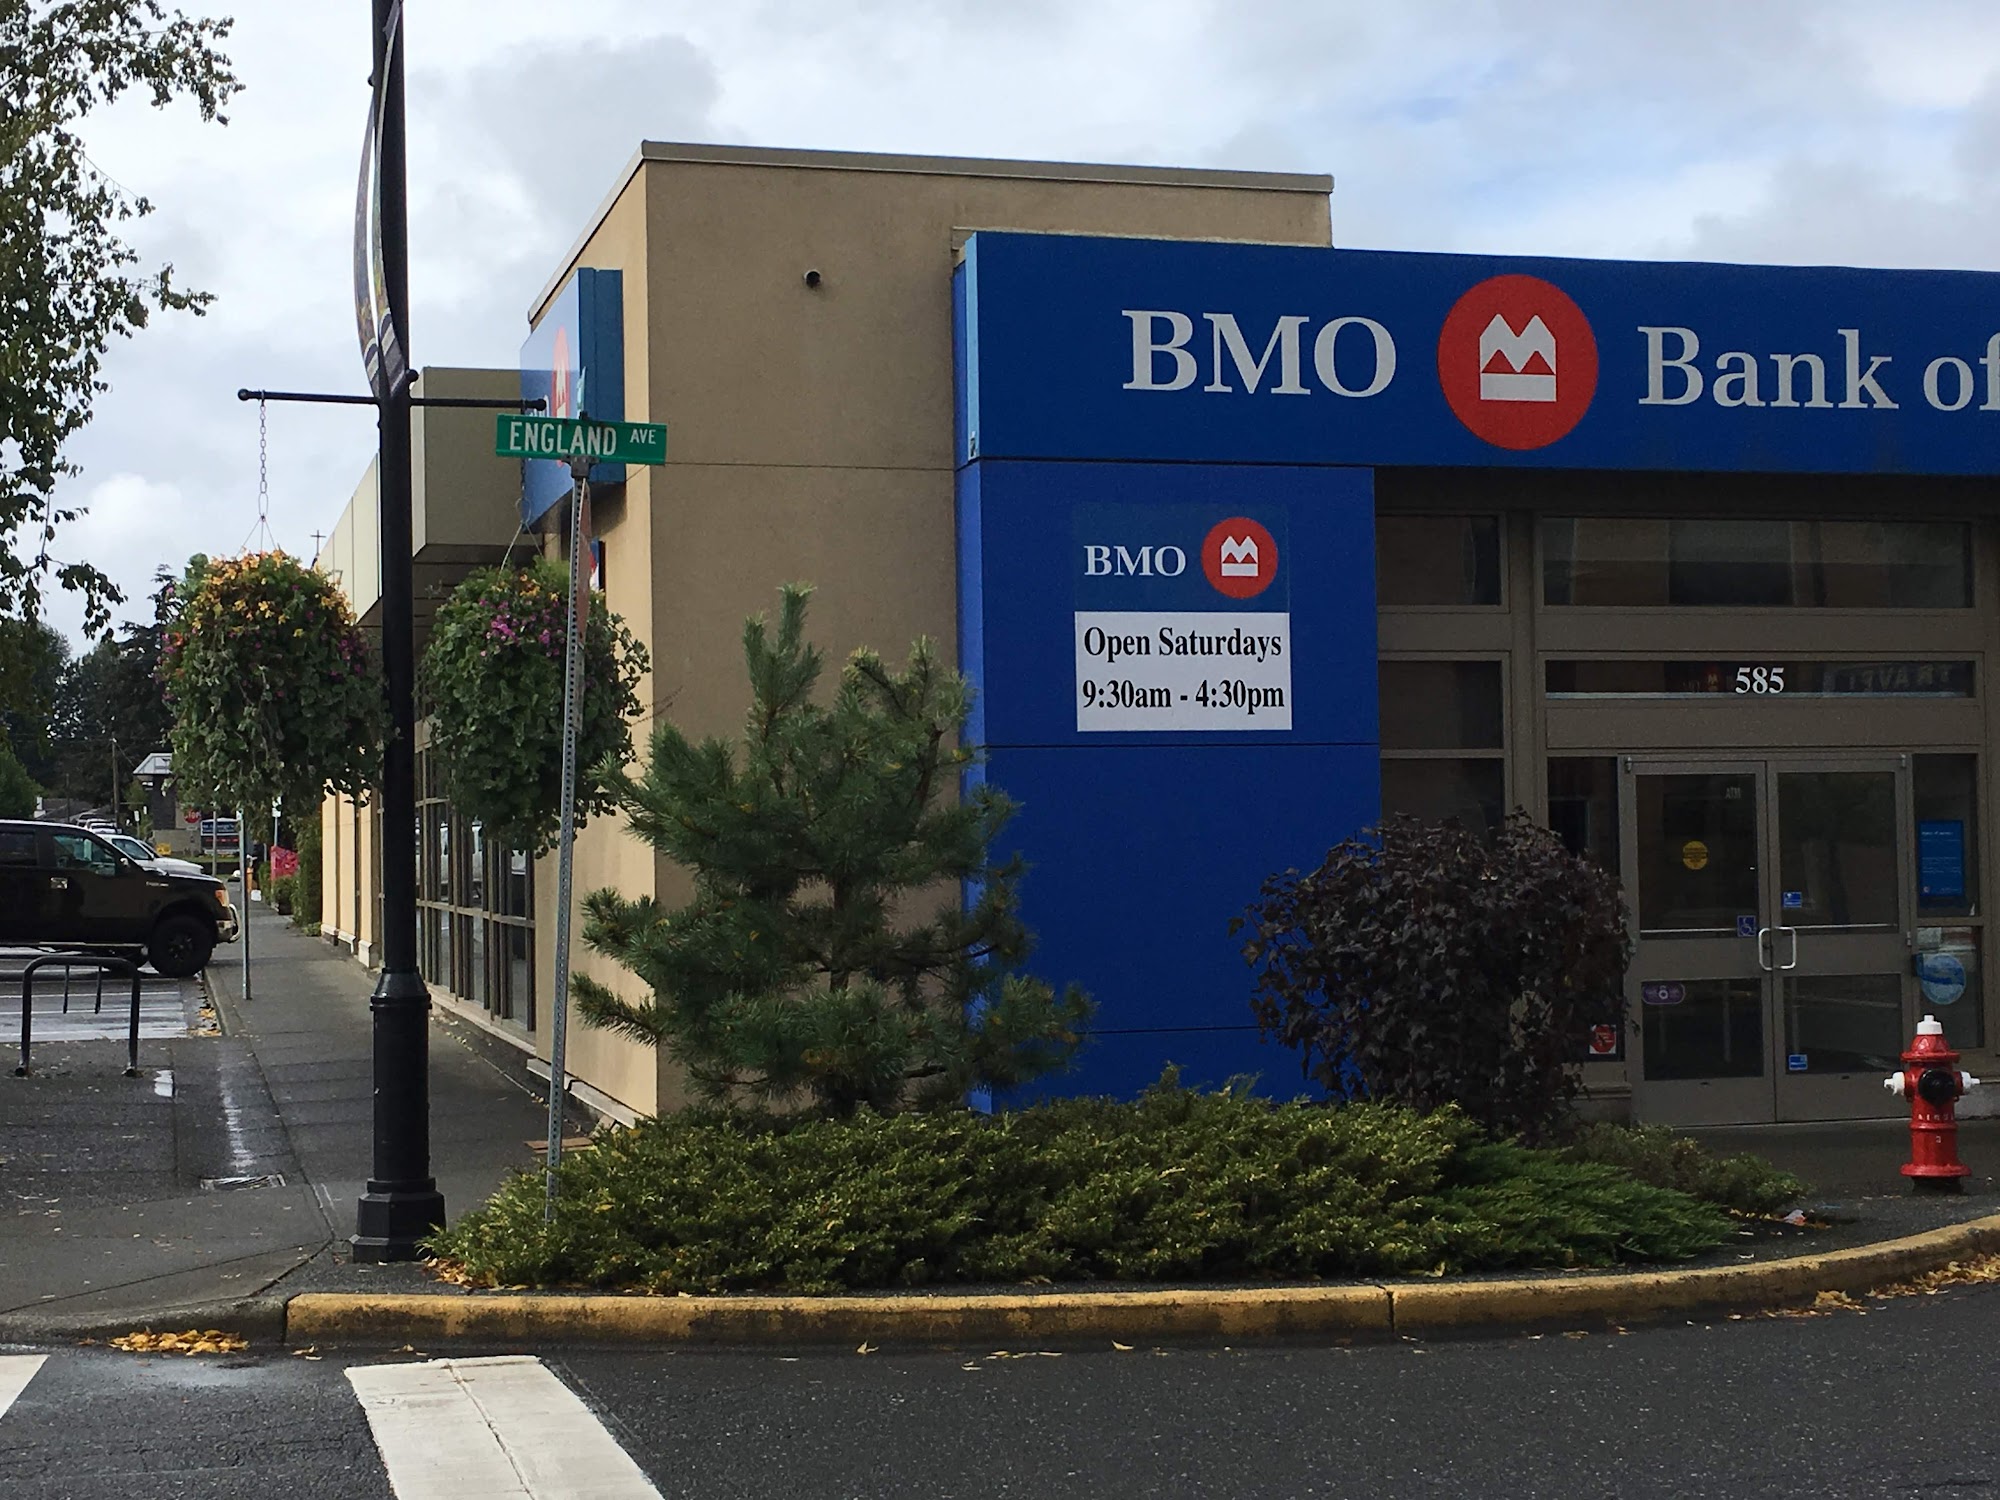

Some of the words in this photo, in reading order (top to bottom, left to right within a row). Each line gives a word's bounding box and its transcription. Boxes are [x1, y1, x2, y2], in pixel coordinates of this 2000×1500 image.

[1121, 309, 1397, 397] BMO
[1637, 325, 1900, 409] Bank
[509, 421, 617, 455] ENGLAND
[630, 428, 657, 444] AVE
[1083, 545, 1187, 577] BMO
[1083, 626, 1151, 663] Open
[1158, 626, 1282, 663] Saturdays
[1082, 679, 1172, 708] 9:30am
[1179, 693, 1188, 702] -
[1195, 679, 1285, 715] 4:30pm
[1735, 666, 1785, 694] 585
